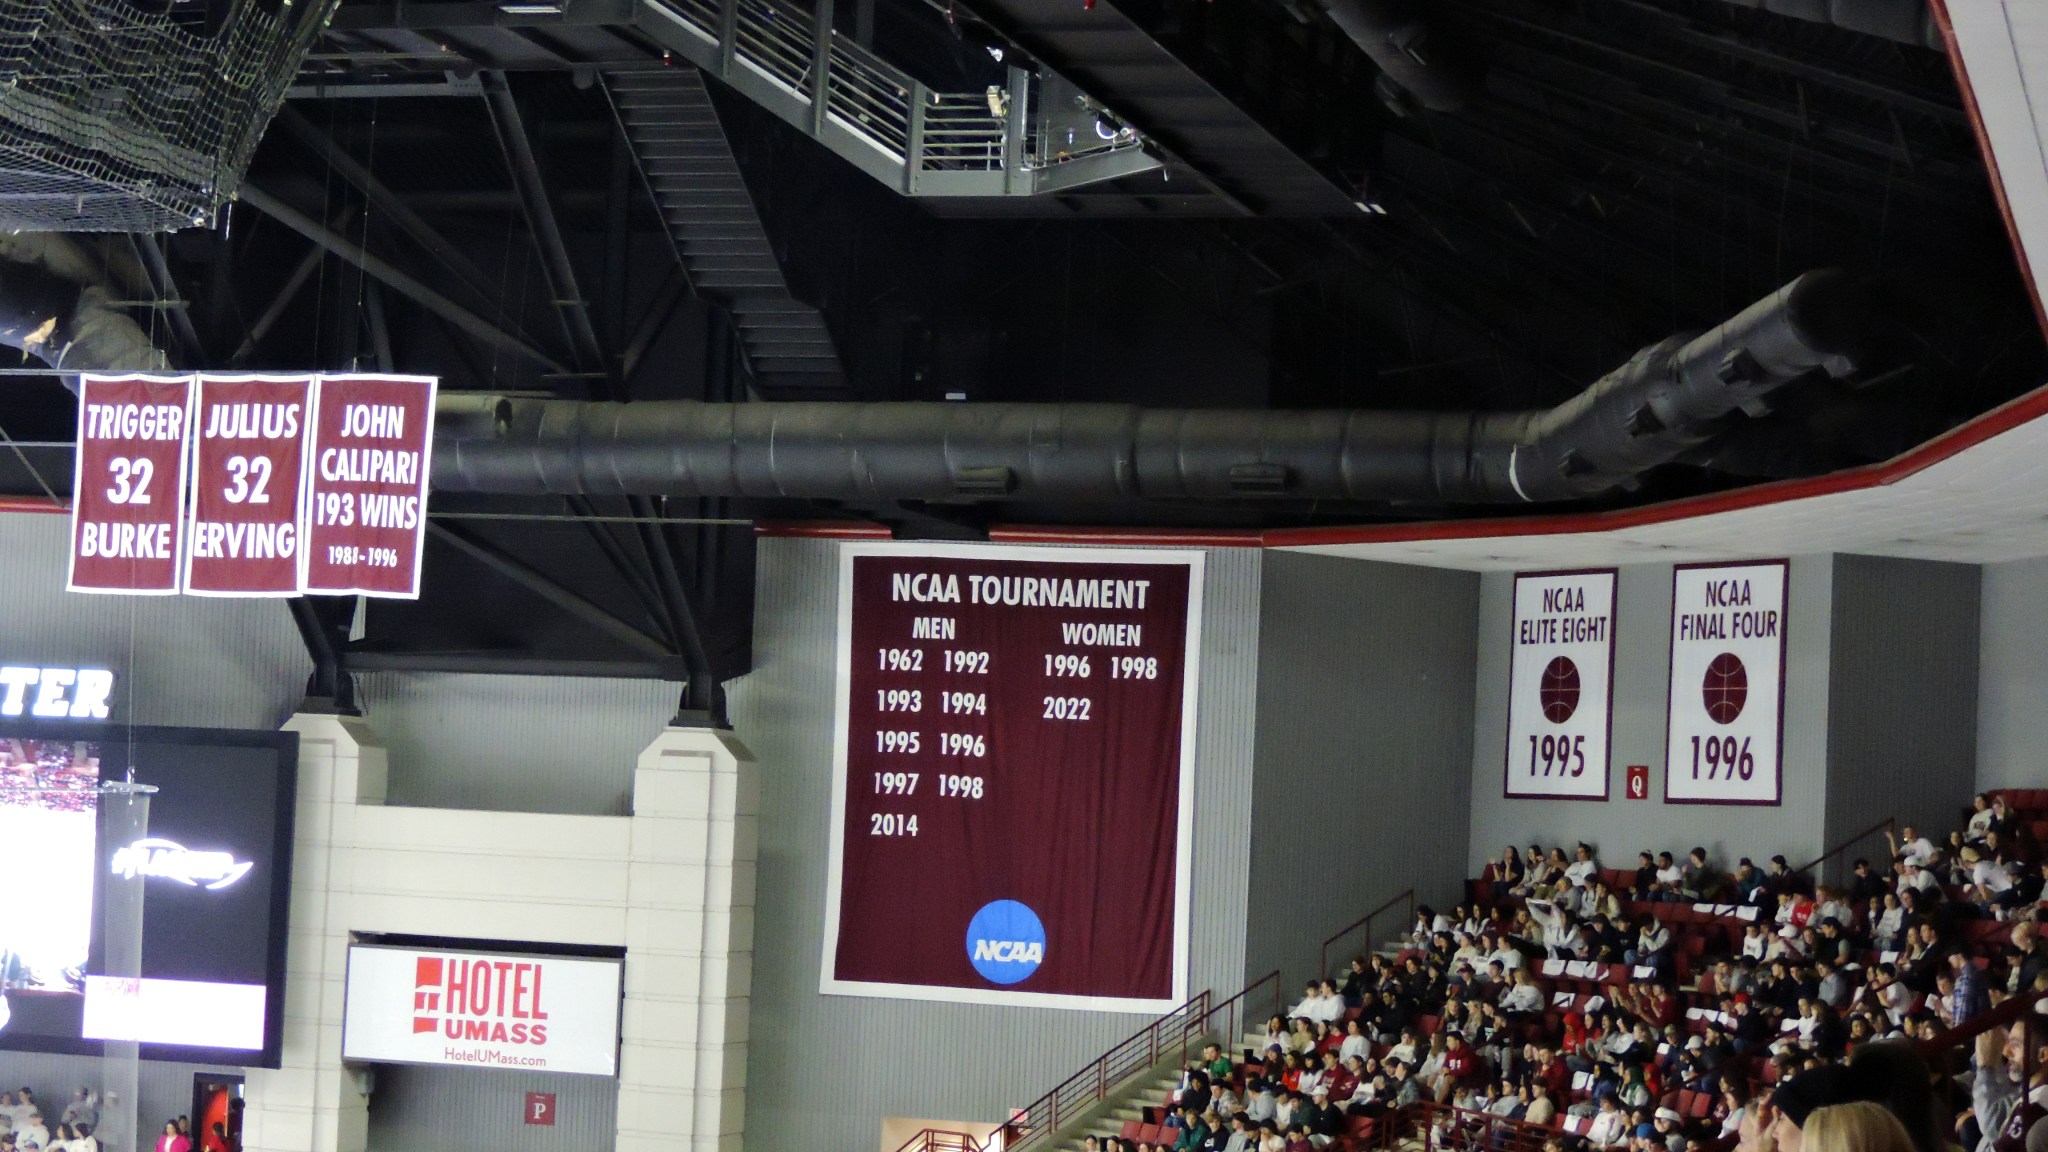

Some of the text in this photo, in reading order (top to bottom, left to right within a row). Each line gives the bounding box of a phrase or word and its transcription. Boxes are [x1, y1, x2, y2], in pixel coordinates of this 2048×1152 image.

[87, 404, 183, 440] TRIGGER
[205, 403, 300, 439] JULIUS
[341, 405, 405, 439] JOHN
[224, 456, 272, 504] 32
[321, 448, 419, 484] CALIPARI
[107, 457, 154, 505] 32
[317, 493, 418, 529] 193 WINS
[81, 522, 171, 559] BURKE
[194, 522, 296, 559] ERVING
[892, 573, 1150, 609] NCAA TOURNAMENT
[1542, 586, 1585, 613] NCAA
[1705, 579, 1752, 608] NCAA
[912, 617, 956, 640] MEN
[1062, 623, 1142, 647] WOMEN
[1520, 616, 1607, 645] ELITE EIGHT
[1680, 610, 1778, 641] FINAL FOUR
[879, 648, 990, 674] 1962 1992
[1045, 655, 1158, 680] 1996 1998
[877, 690, 986, 716] 1993 1994
[1042, 697, 1091, 721] 2022
[876, 731, 985, 757] 1995 1996
[1529, 735, 1585, 778] 1995
[1691, 735, 1754, 781] 1996
[874, 772, 984, 799] 1997 1998
[1631, 775, 1642, 797] Q
[870, 814, 918, 837] 2014
[974, 939, 1042, 964] NCAA
[447, 959, 548, 1019] HOTEL
[445, 1019, 547, 1045] UMASS
[445, 1047, 546, 1066] HotelUMass.com
[533, 1102, 547, 1119] P
